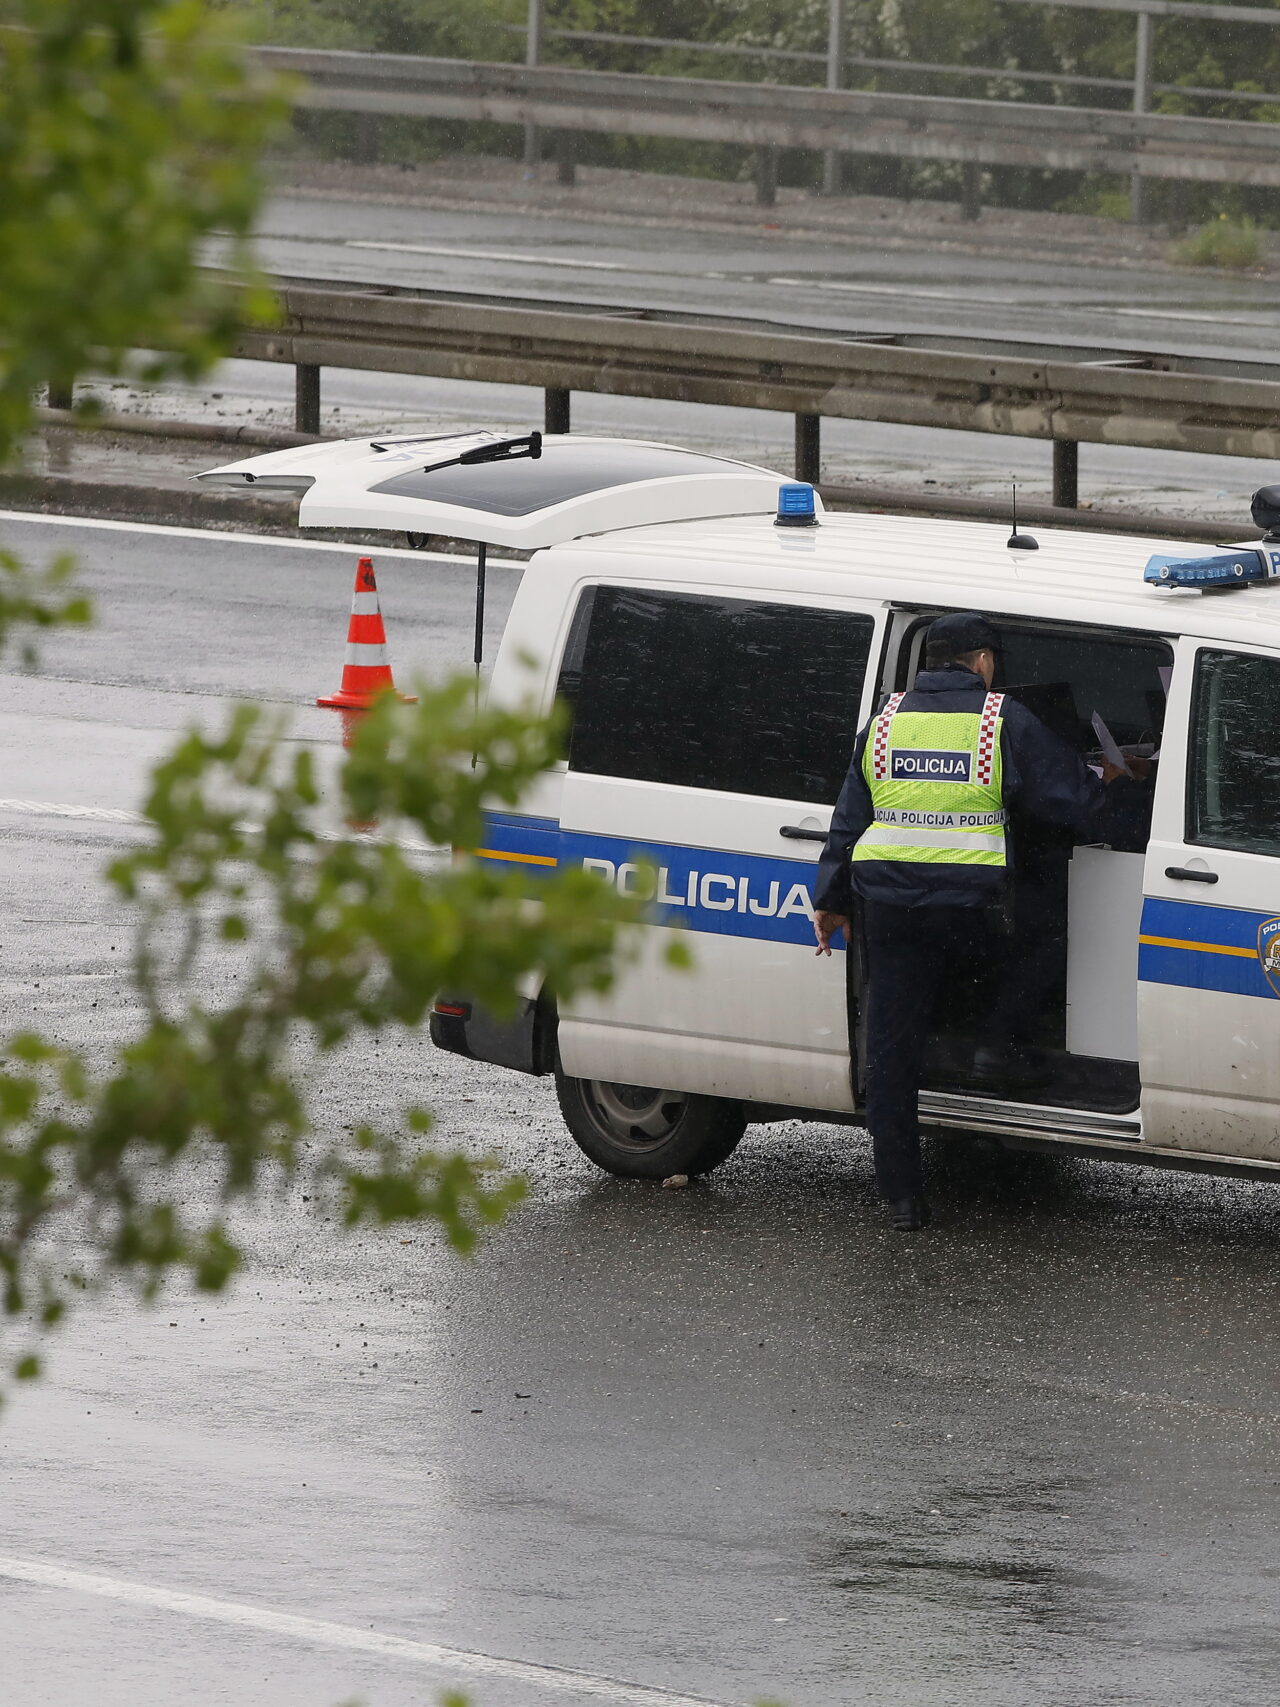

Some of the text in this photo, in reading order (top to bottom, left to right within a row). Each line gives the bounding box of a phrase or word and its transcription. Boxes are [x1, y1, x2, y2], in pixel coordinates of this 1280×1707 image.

[894, 757, 967, 775] POLICIJA
[901, 812, 954, 826] POLICIJA
[959, 811, 1004, 826] POLICIJA
